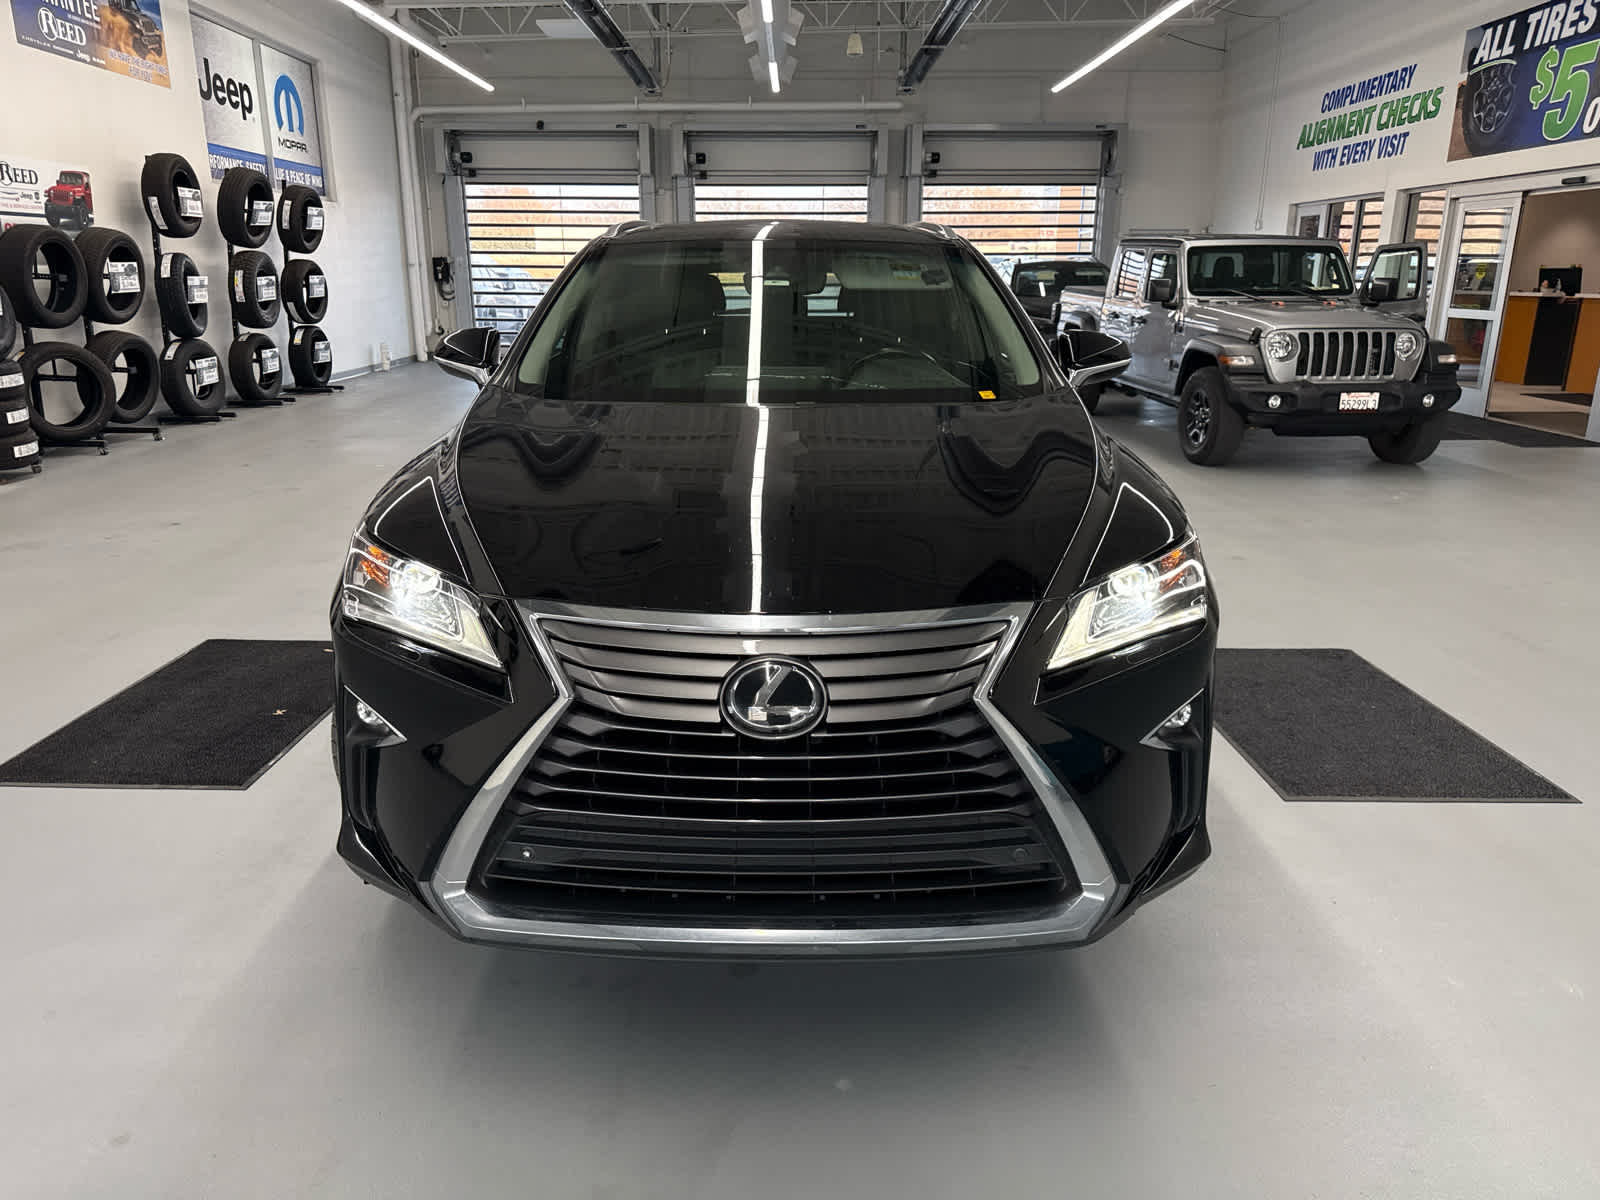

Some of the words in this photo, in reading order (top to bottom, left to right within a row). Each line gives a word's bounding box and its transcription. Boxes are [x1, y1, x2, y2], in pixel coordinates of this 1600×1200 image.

[39, 8, 87, 46] REED
[1473, 20, 1517, 65] ALL
[1523, 0, 1600, 50] TIRES
[198, 57, 253, 120] Jeep
[1321, 64, 1417, 114] COMPLIMENTARY
[1297, 104, 1377, 150] ALIGNMENT
[1376, 87, 1444, 131] CHECKS
[278, 137, 308, 153] MOPAR
[1312, 149, 1337, 171] WITH
[1339, 139, 1376, 167] EVERY
[1377, 132, 1409, 159] VISIT
